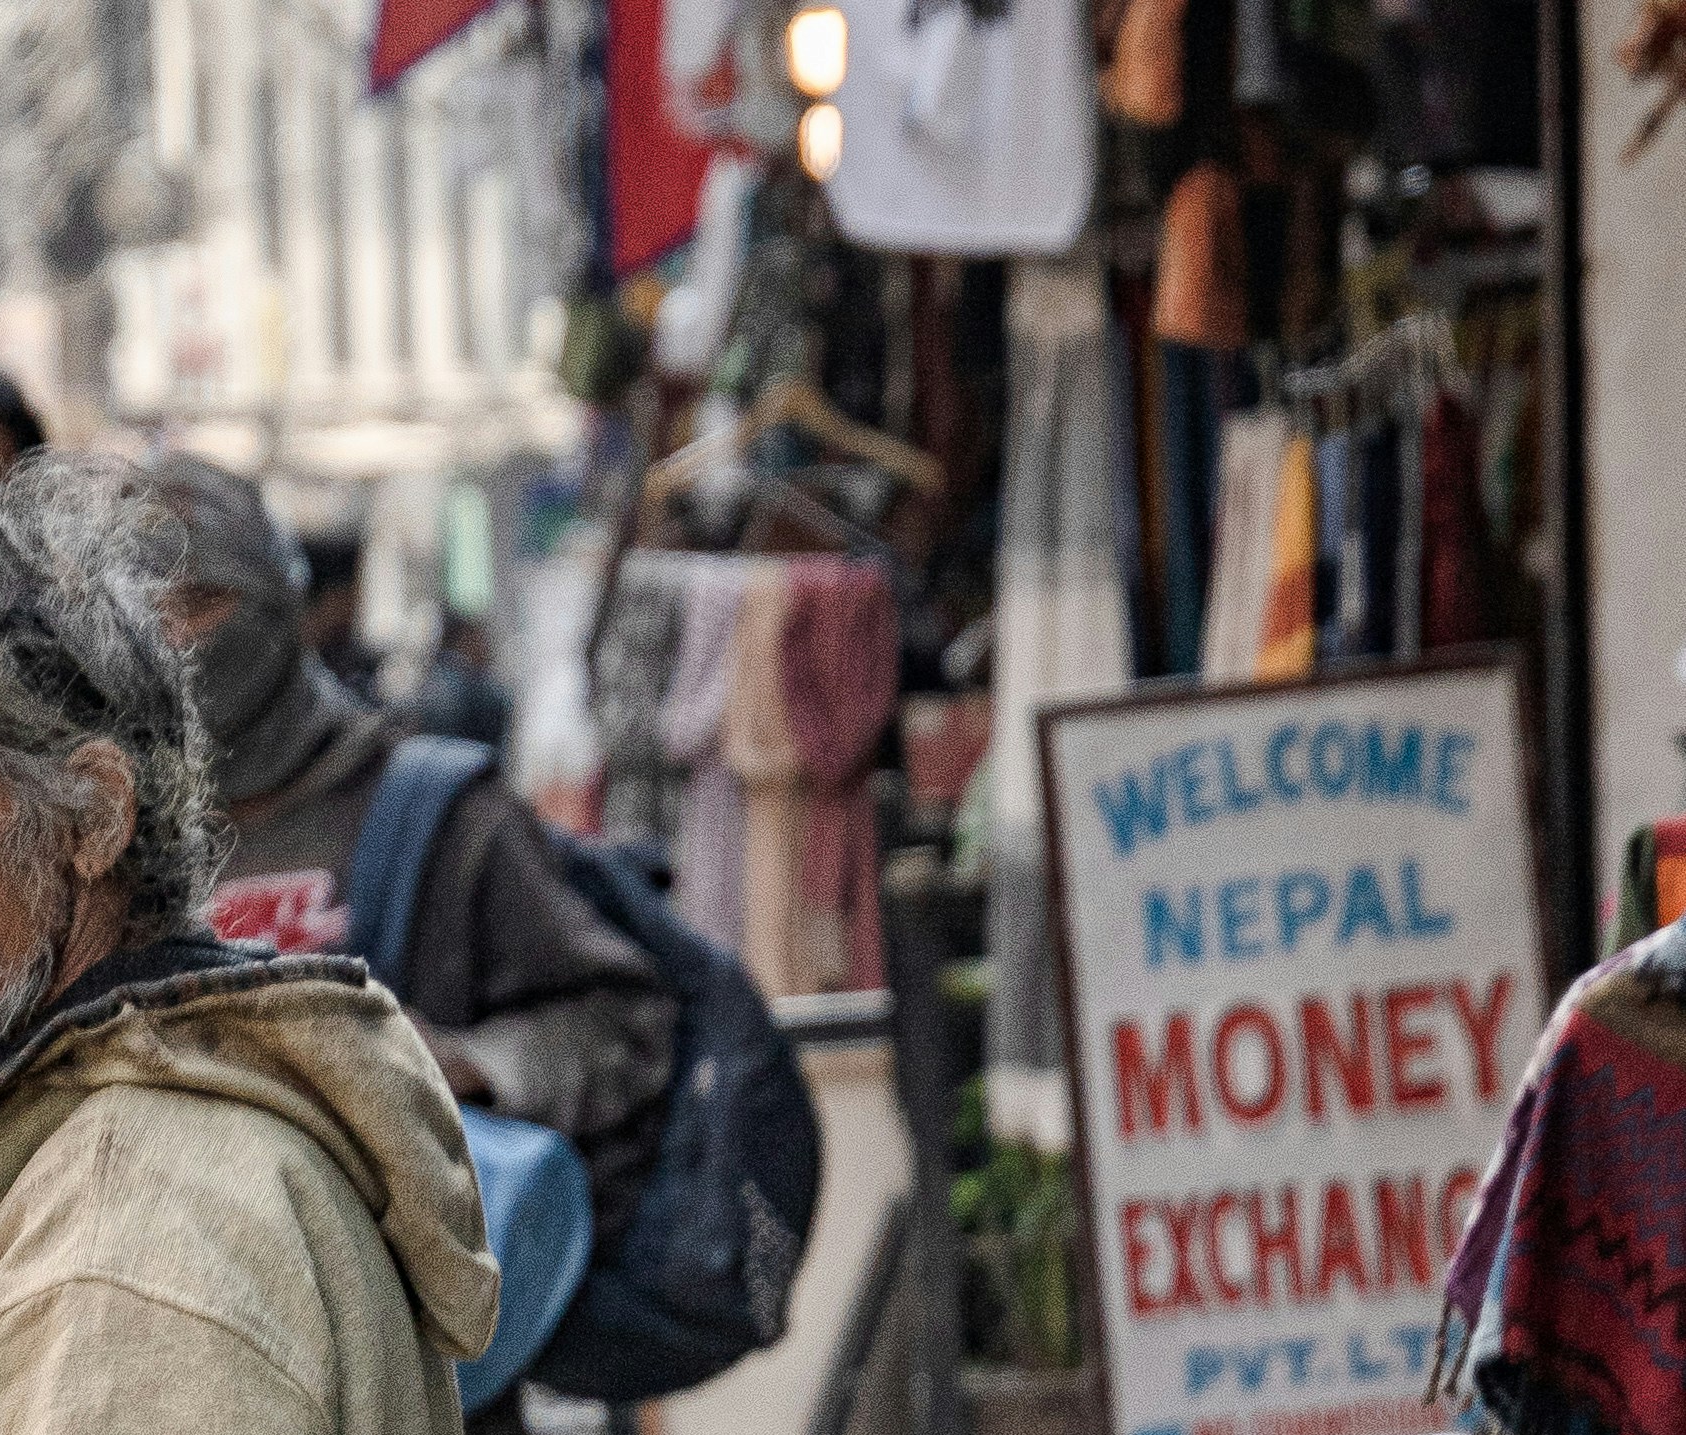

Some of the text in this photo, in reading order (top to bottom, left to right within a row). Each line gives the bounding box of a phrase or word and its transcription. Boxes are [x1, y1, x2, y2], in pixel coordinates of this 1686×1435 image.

[1092, 721, 1477, 856] WELCOME
[1143, 860, 1455, 966] NEPAL
[1108, 974, 1512, 1141] MONEY
